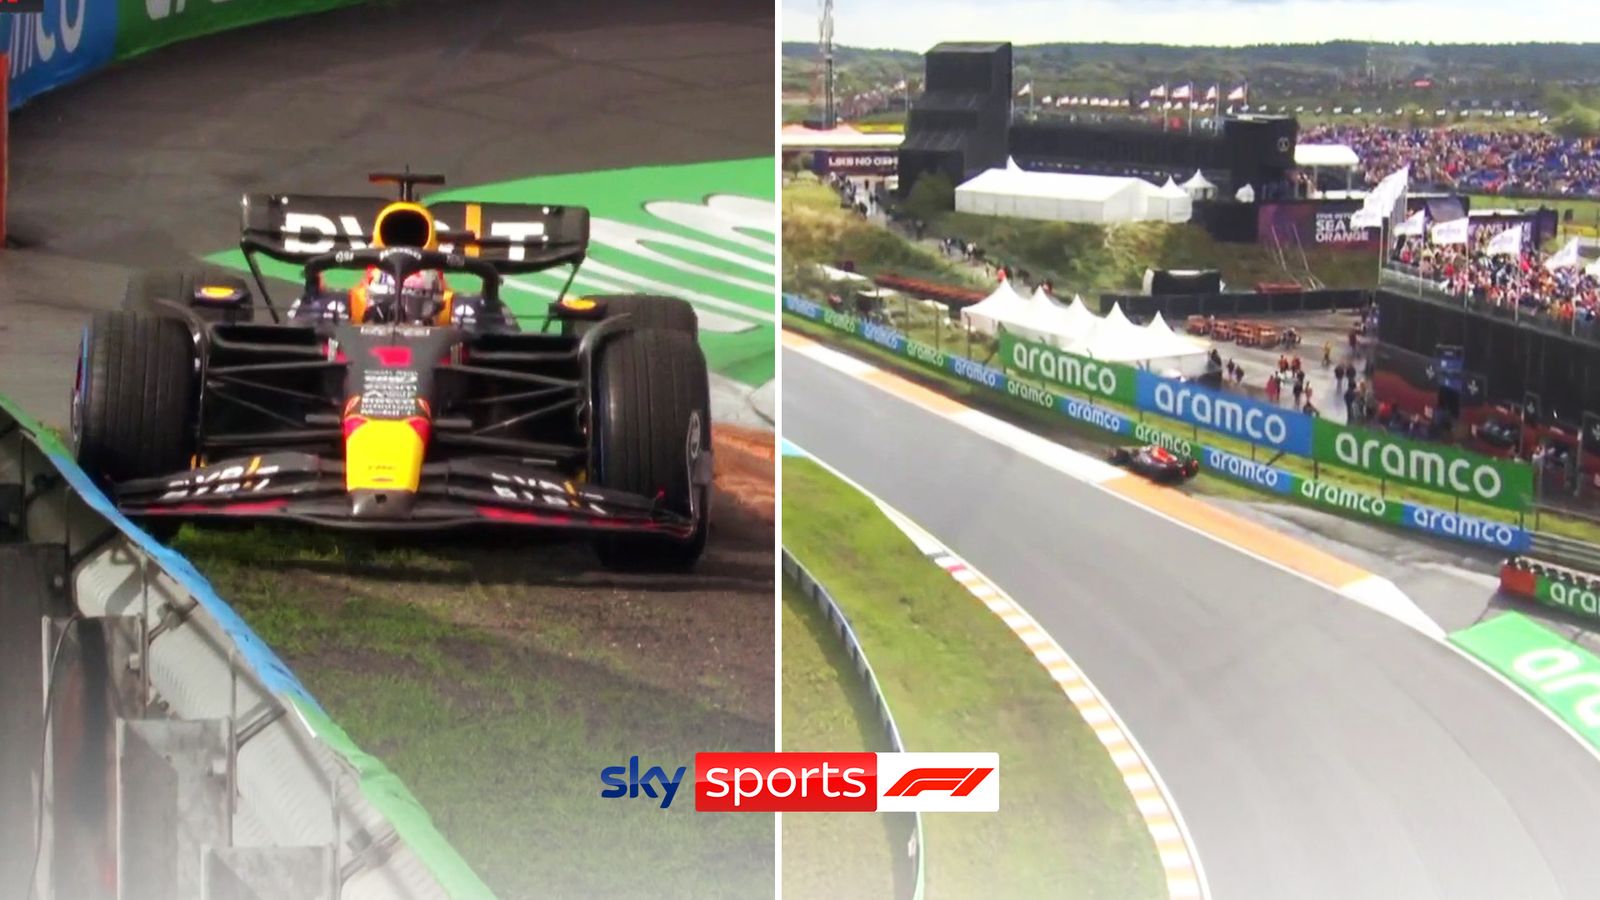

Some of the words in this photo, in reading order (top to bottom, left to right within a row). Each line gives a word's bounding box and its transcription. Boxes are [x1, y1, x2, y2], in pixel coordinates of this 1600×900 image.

[1315, 231, 1369, 243] ORANGE
[1316, 220, 1346, 232] SEA
[864, 323, 899, 350] aramco
[906, 341, 944, 367] aramco
[1013, 342, 1116, 395] aramco
[954, 359, 996, 386] aramco
[1007, 379, 1054, 408] aramco
[1068, 400, 1120, 431] aramco
[1154, 383, 1287, 444] aramco
[1135, 422, 1191, 456] aramco
[1210, 452, 1278, 488] aramco
[1335, 432, 1501, 499] aramco
[1300, 479, 1386, 517] aramco
[1413, 508, 1513, 545] aramco
[1550, 582, 1600, 613] ara
